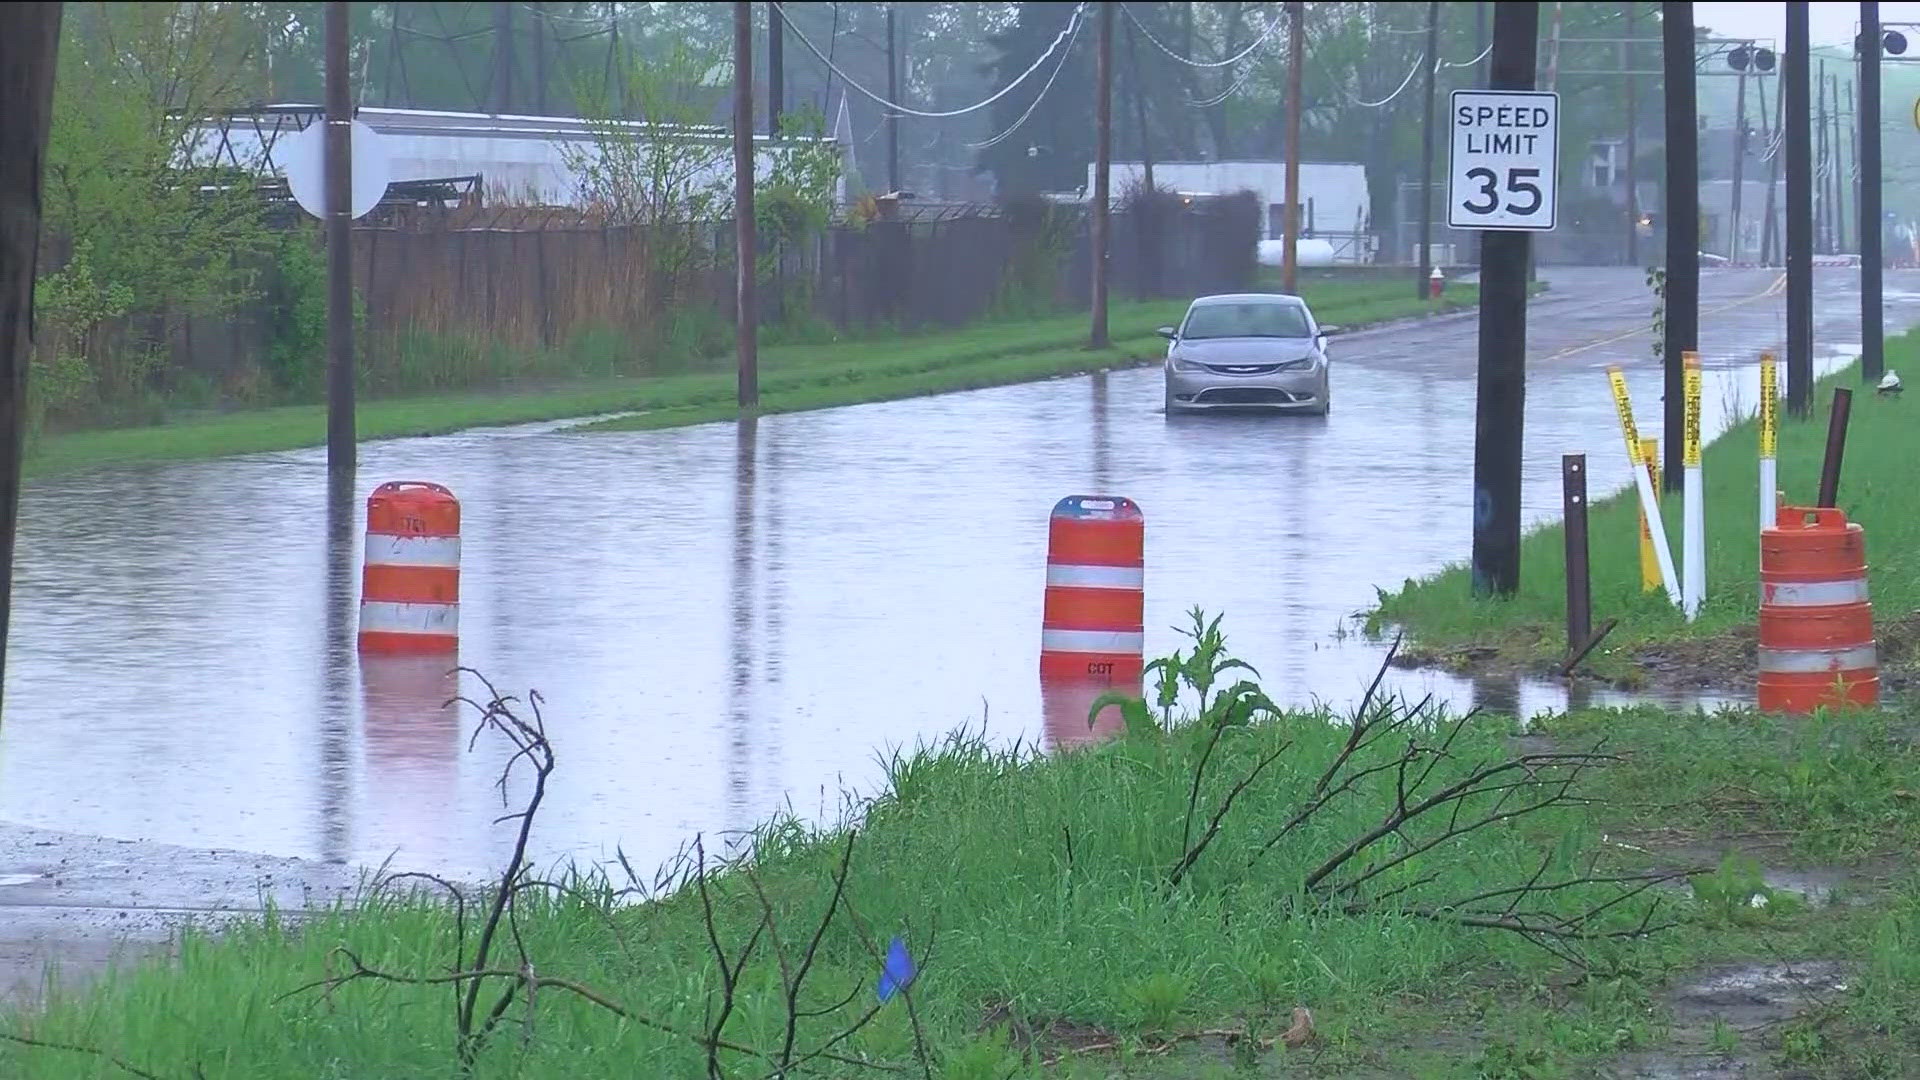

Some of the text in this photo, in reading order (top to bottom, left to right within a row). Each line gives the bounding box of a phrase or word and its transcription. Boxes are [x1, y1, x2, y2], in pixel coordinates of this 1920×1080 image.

[1458, 106, 1549, 128] SPEED
[1467, 133, 1538, 155] LIMIT
[1462, 167, 1542, 216] 35
